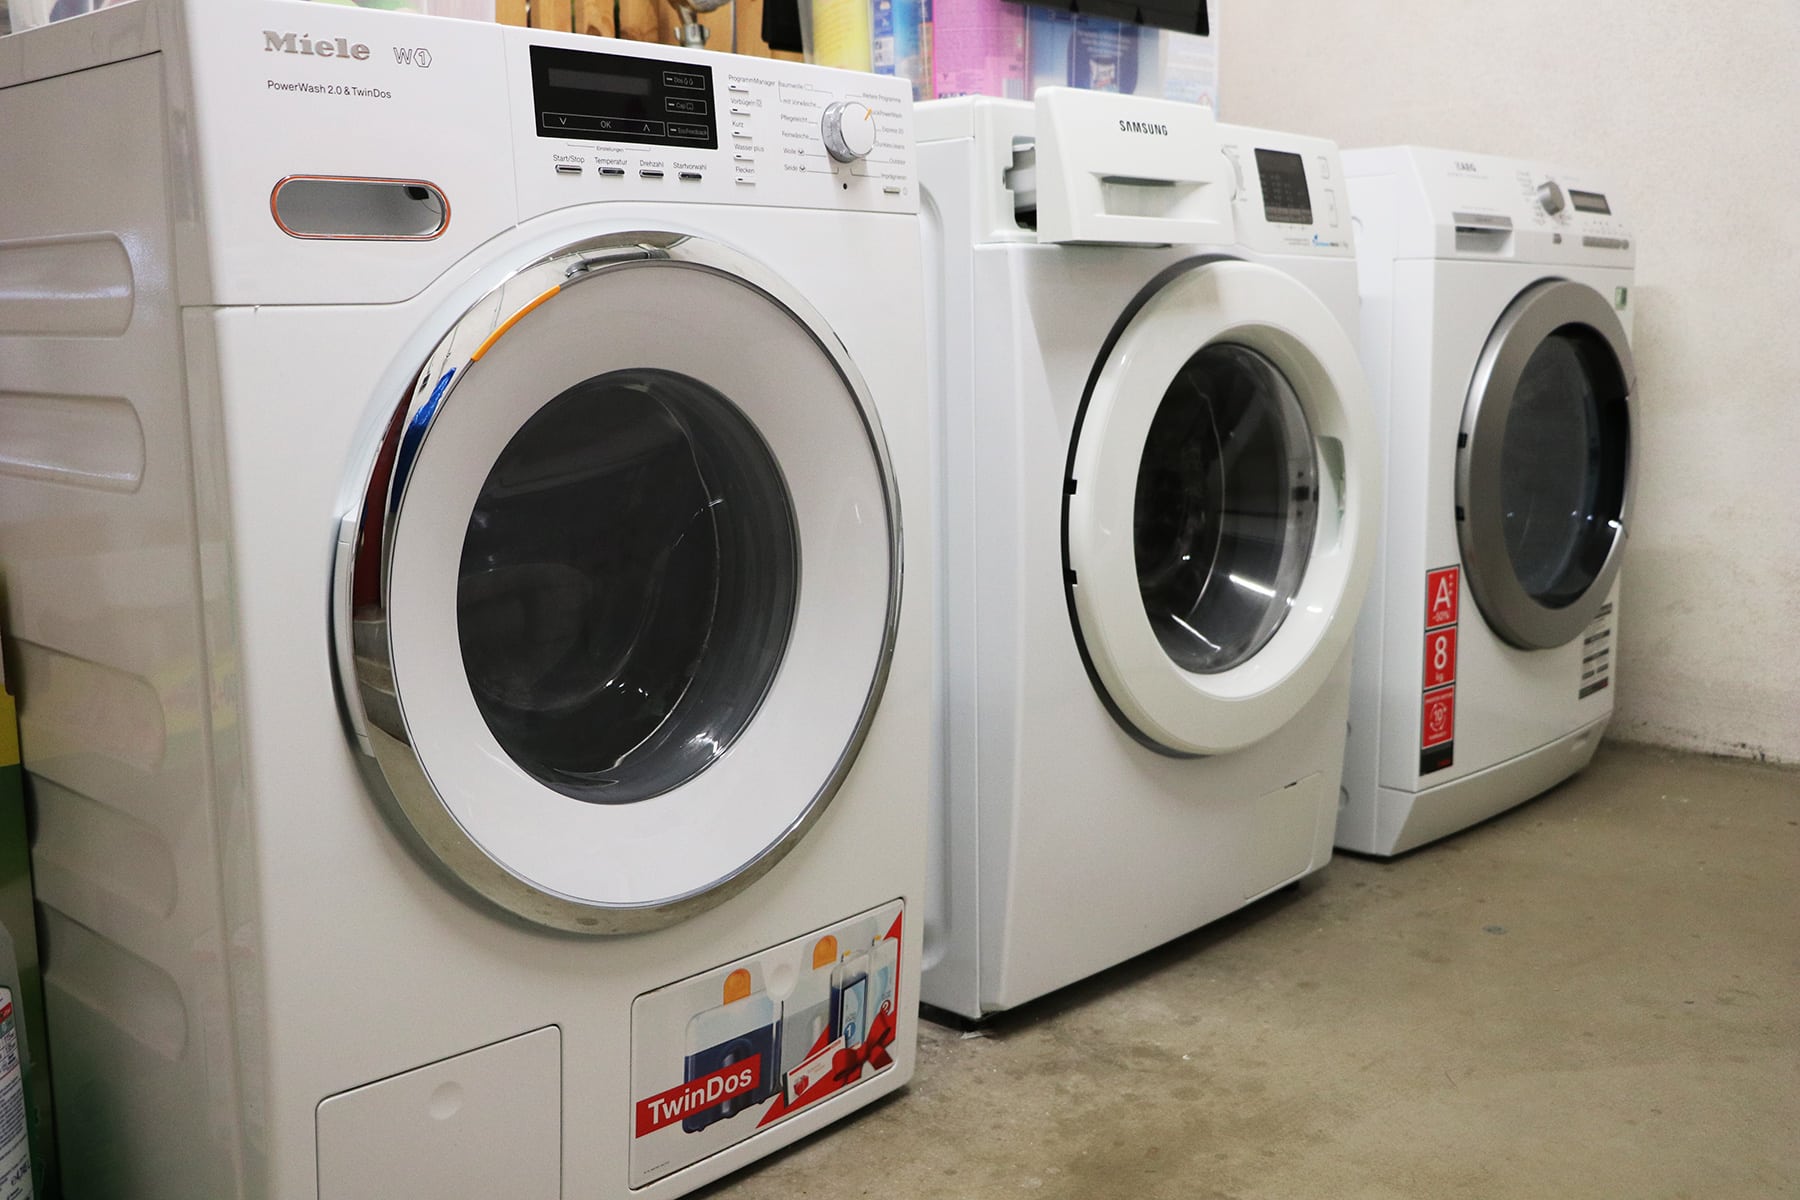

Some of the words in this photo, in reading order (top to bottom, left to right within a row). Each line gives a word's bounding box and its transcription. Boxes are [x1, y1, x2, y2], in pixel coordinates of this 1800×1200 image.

[262, 30, 370, 61] Miele
[267, 79, 326, 95] PowerWash
[327, 84, 343, 96] 2.0
[343, 86, 351, 96] &
[352, 87, 392, 99] TwinDos
[600, 121, 612, 129] OK
[732, 120, 744, 128] Kurz
[1119, 120, 1169, 136] SAMSUNG
[734, 143, 753, 151] Wasser
[753, 144, 765, 152] plus
[553, 154, 585, 164] Start/Stop
[594, 157, 628, 166] Temperatur
[639, 160, 664, 168] Drehzahl
[672, 162, 707, 171] Startvorwahl
[735, 166, 755, 174] Flecken
[1434, 635, 1447, 670] 8
[648, 1068, 753, 1126] TwinDos
